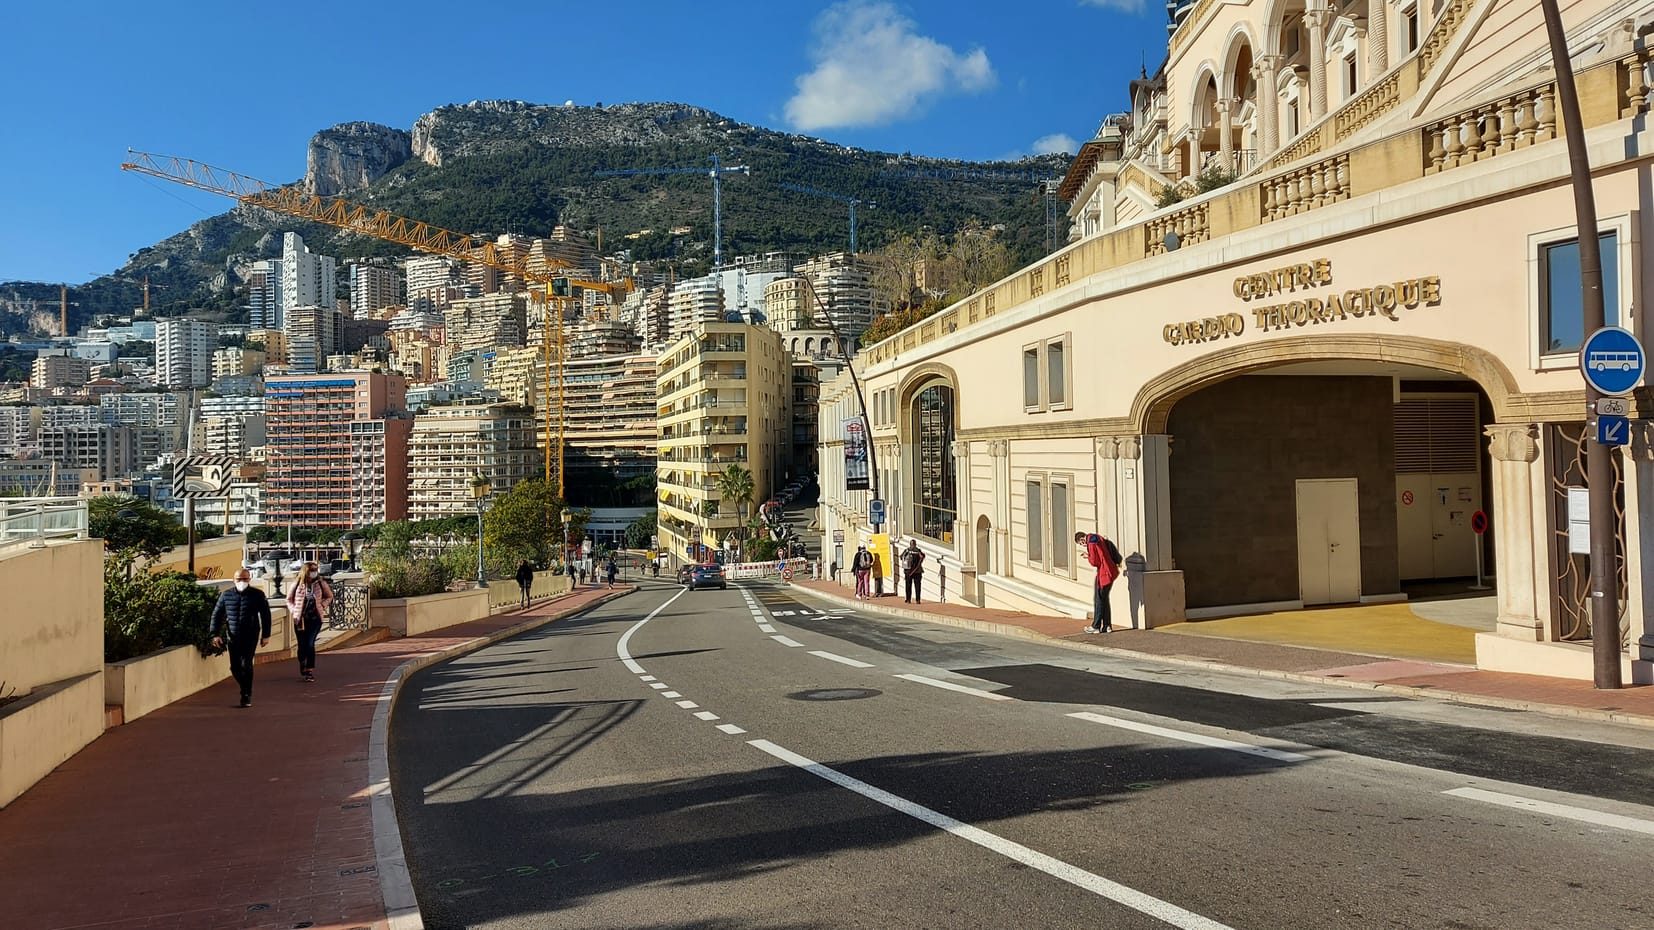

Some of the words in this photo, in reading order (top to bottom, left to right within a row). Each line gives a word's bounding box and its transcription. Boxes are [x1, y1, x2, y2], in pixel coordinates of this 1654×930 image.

[1233, 258, 1332, 299] CENTRE
[1163, 312, 1243, 345] CARDIO
[1252, 275, 1441, 331] THORACIQUE
